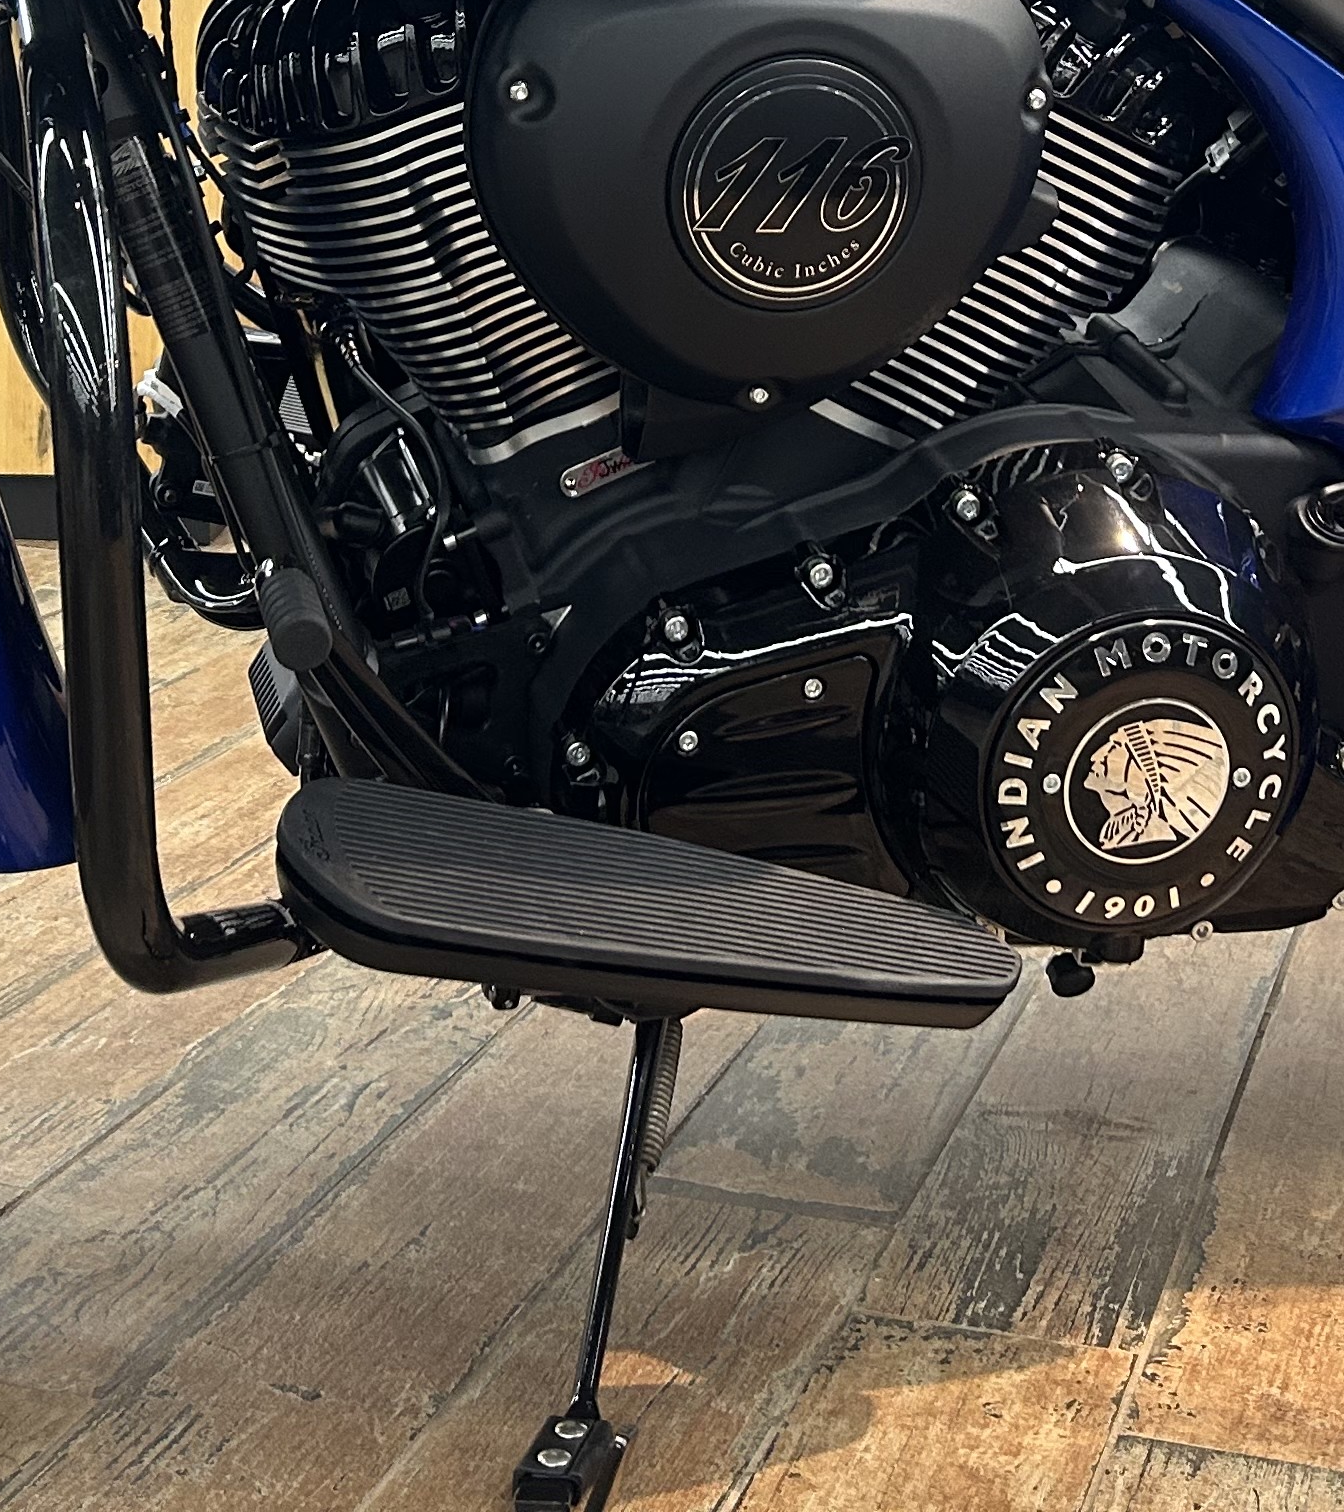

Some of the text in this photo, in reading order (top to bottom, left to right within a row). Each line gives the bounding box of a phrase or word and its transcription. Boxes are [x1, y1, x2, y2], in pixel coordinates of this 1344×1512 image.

[693, 135, 912, 233] 116
[729, 239, 861, 279] Cubic Inches
[997, 632, 1287, 871] INDIAN MOTORCYCLE
[1074, 886, 1181, 919] 1901
